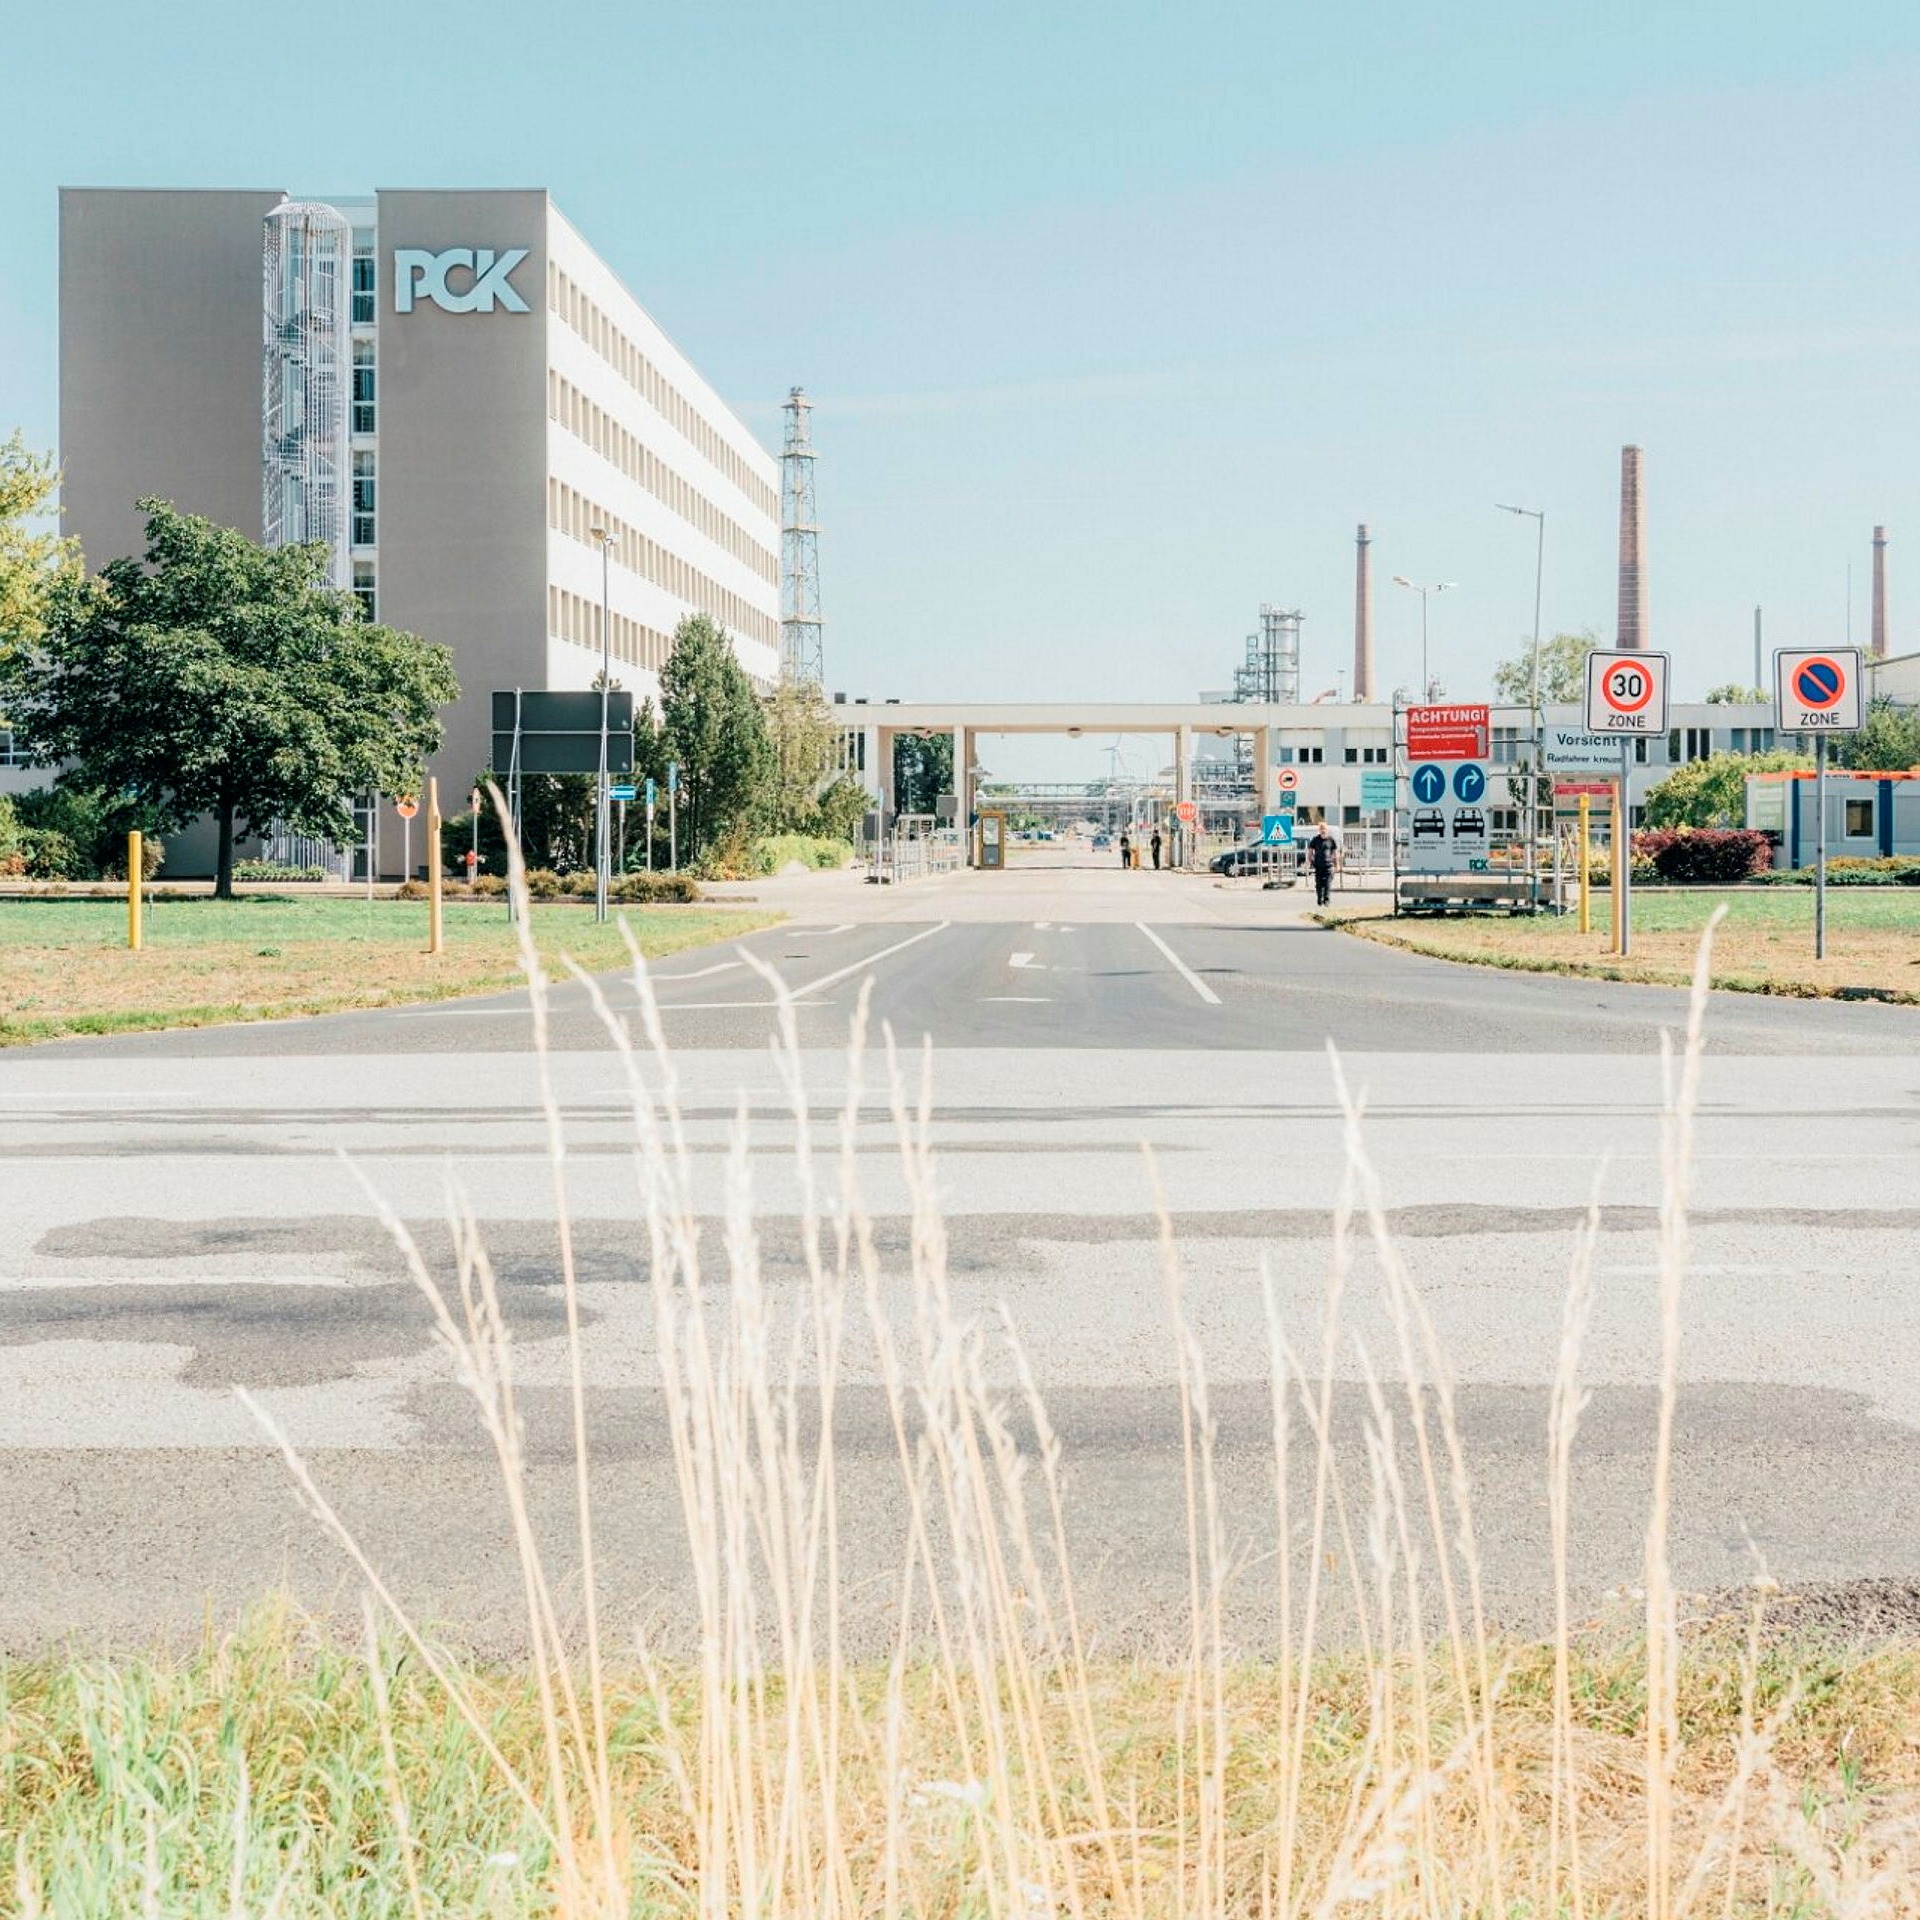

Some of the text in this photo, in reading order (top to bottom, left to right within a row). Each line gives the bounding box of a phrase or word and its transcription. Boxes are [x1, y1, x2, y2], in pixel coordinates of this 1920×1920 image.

[394, 248, 531, 313] PCK
[1613, 674, 1642, 697] 30
[1410, 709, 1485, 723] ACHTUNG!
[1607, 714, 1645, 728] ZONE
[1800, 713, 1840, 726] ZONE
[1469, 859, 1488, 870] PCK
